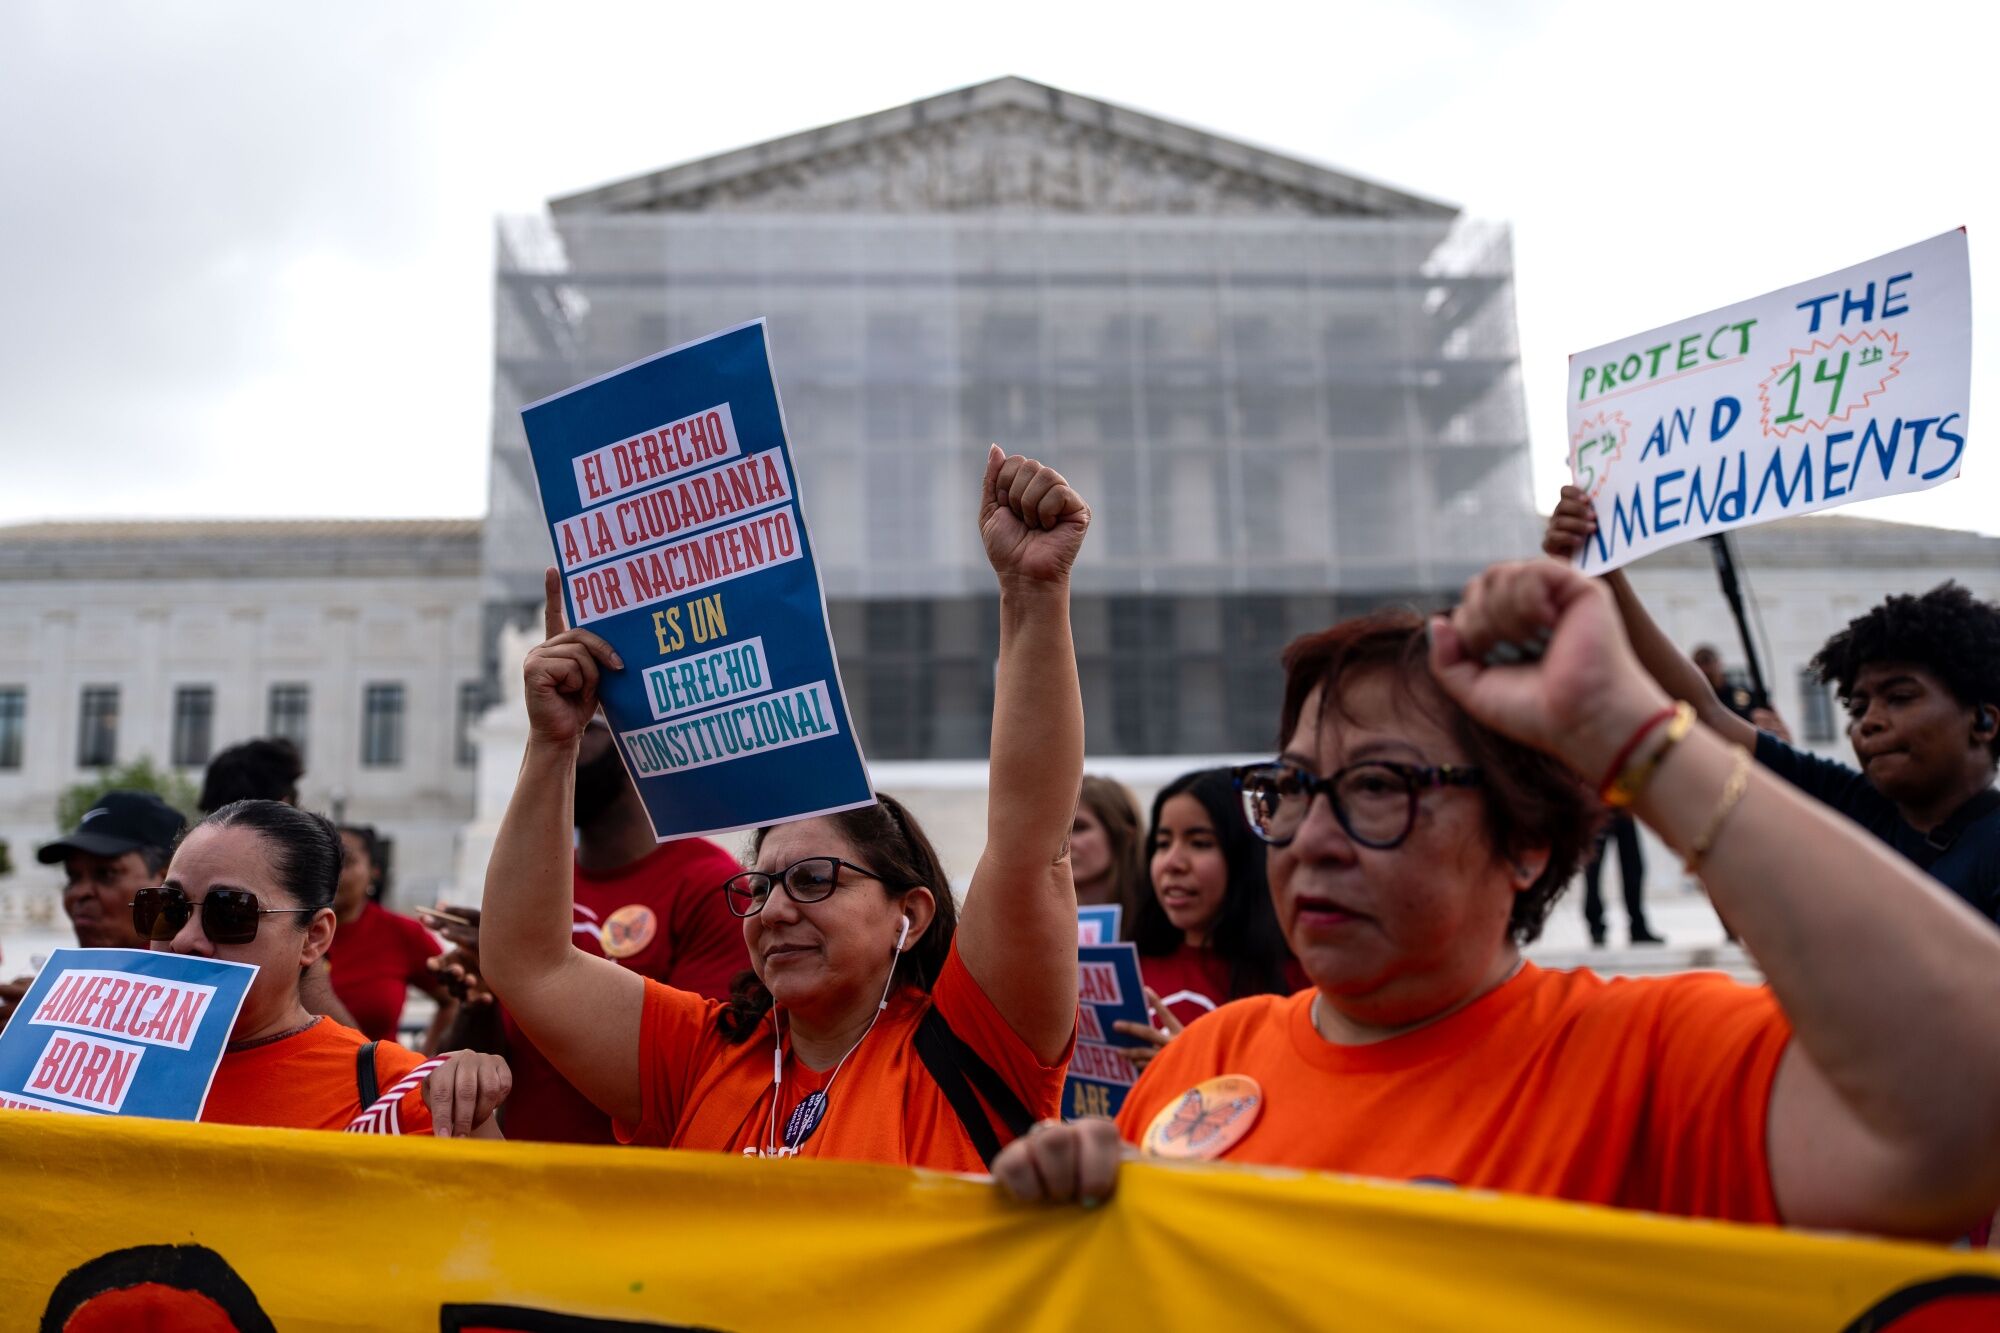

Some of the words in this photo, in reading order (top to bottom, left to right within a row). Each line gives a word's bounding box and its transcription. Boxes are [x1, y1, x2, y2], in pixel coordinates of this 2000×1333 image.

[1578, 318, 1758, 400] PROTECT
[1796, 271, 1913, 333] THE
[1640, 396, 1742, 462] AND
[1774, 346, 1884, 424] 14th
[582, 456, 611, 500] EL
[612, 411, 728, 489] DERECHO
[563, 523, 582, 566] A
[582, 510, 617, 557] LA
[617, 451, 786, 543] CIUDADANÍA
[573, 570, 628, 620] POR
[627, 511, 796, 604] NACIMIENTO
[652, 610, 685, 655] ES
[690, 593, 728, 644] UN
[650, 644, 762, 715] DERECHO
[627, 688, 831, 775] CONSTITUCIONAL
[35, 975, 207, 1045] AMERICAN
[31, 1037, 138, 1106] BORN
